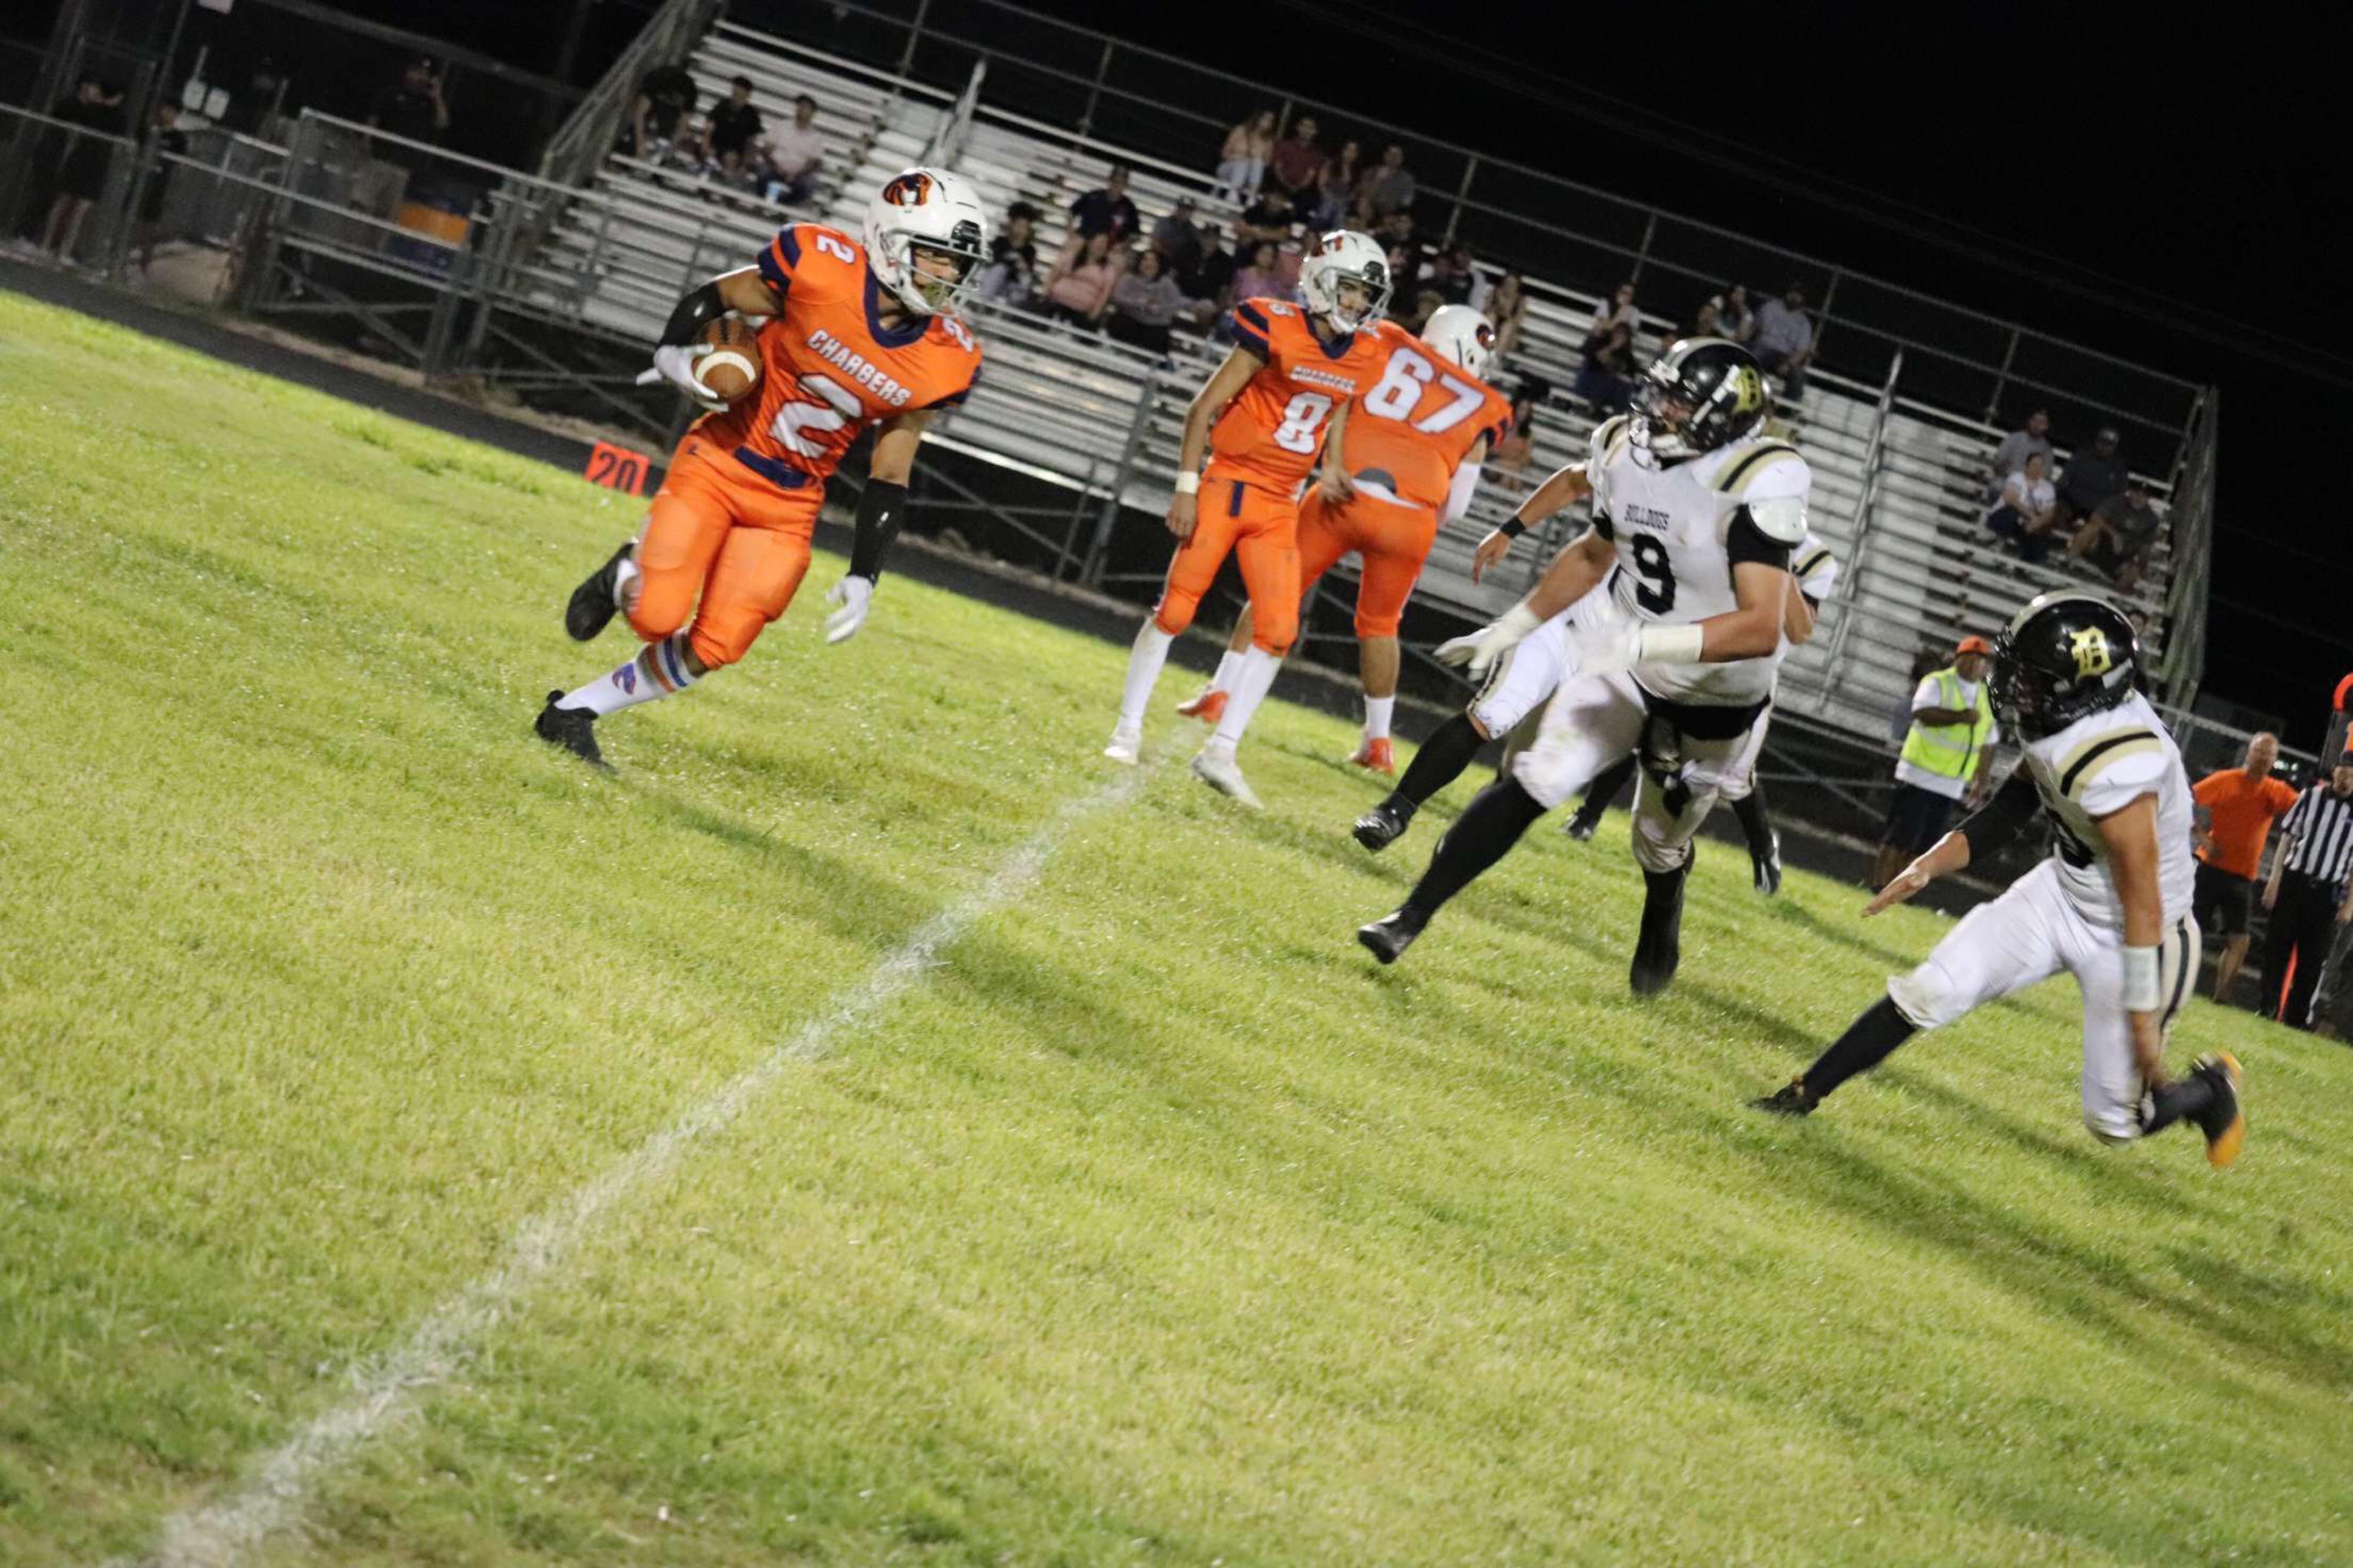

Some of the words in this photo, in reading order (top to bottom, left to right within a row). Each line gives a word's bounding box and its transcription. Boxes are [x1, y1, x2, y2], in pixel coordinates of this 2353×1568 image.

[816, 235, 854, 263] 2
[771, 373, 862, 459] 2
[1274, 392, 1332, 454] 8
[1364, 346, 1486, 434] 67
[592, 451, 638, 493] 20
[1632, 533, 1676, 615] 9
